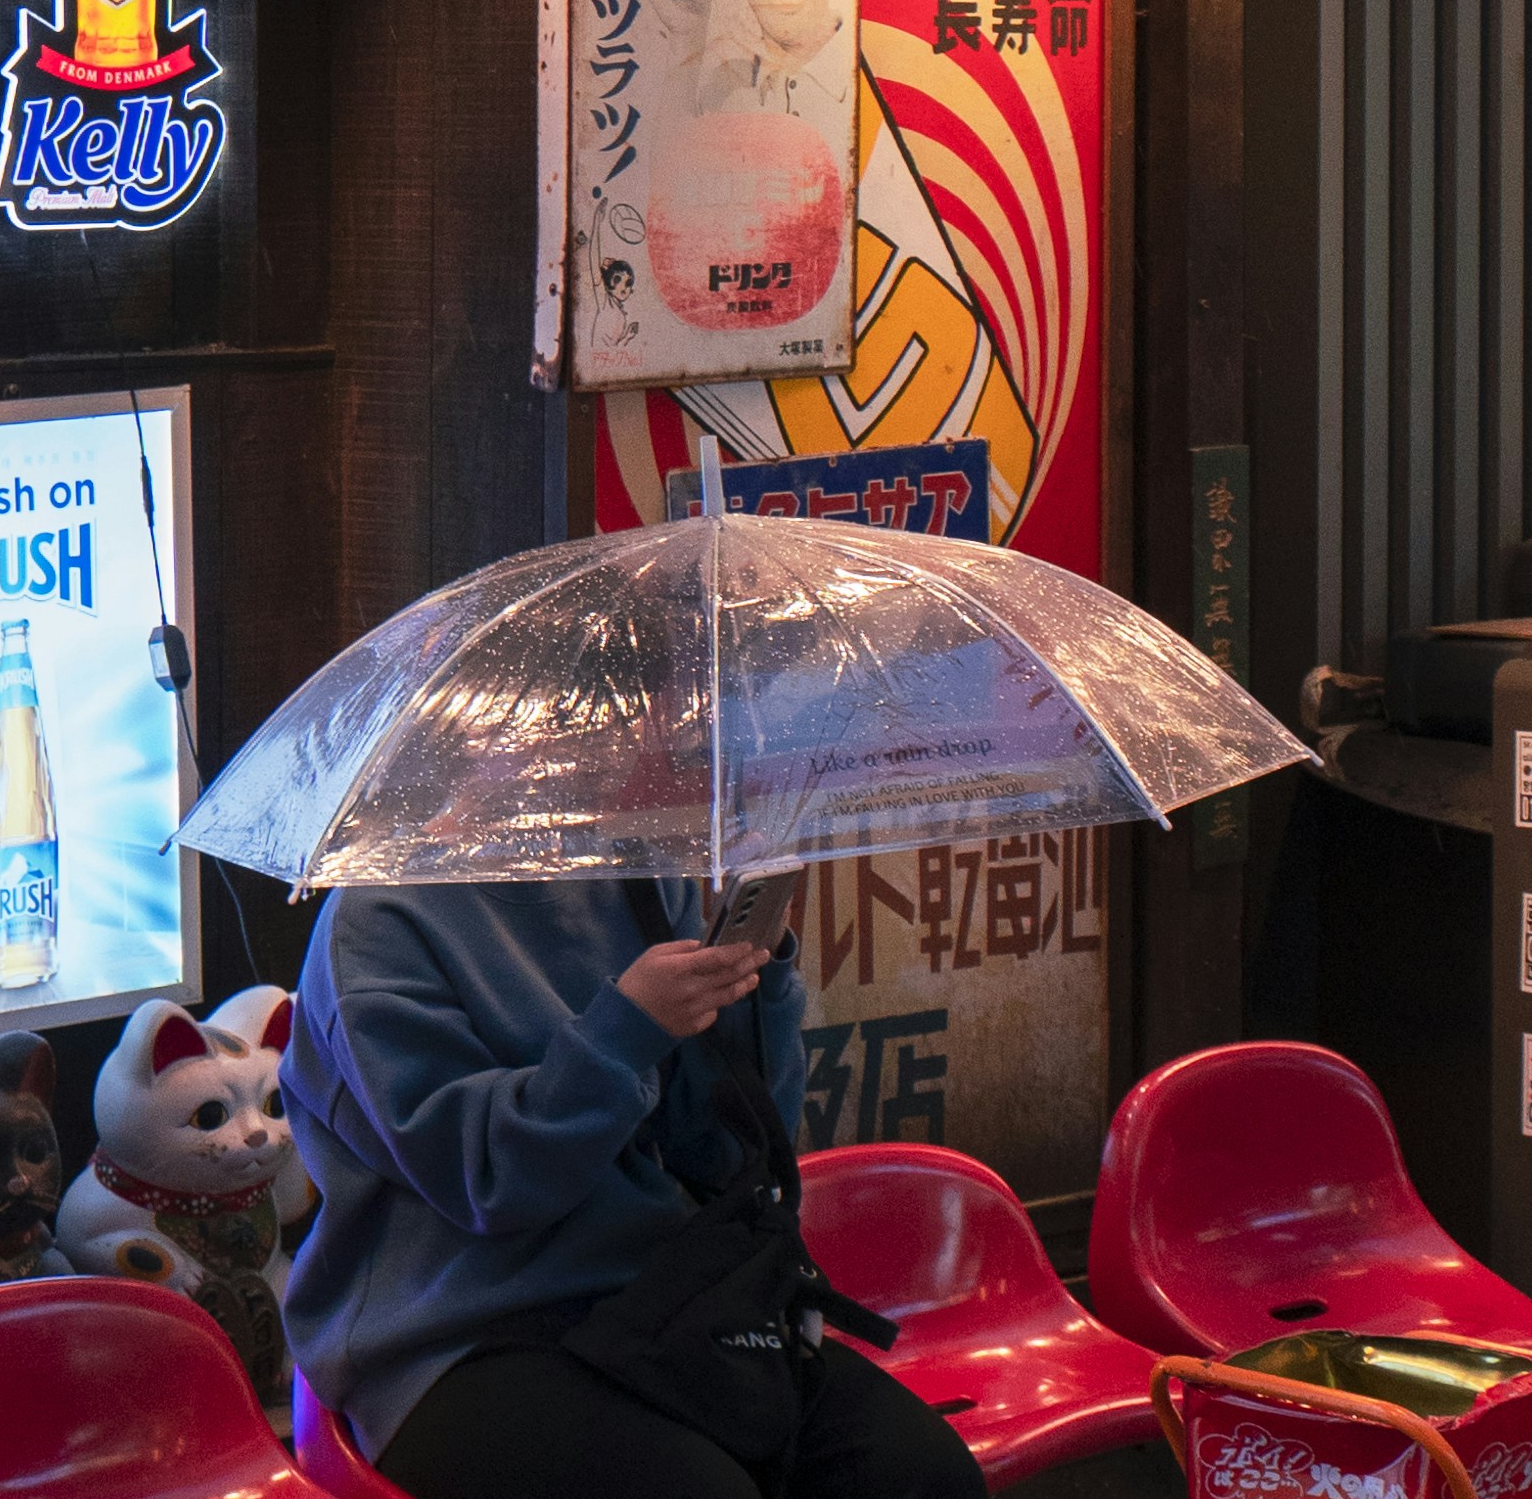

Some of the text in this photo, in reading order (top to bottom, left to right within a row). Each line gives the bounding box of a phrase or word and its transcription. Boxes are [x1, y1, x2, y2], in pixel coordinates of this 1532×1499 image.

[58, 58, 173, 87] FROM DENMARK
[11, 95, 215, 213] Kelly
[26, 184, 120, 213] Premium Malt
[708, 261, 792, 293] ドリンク
[778, 339, 824, 357] 大塚製薬
[49, 477, 97, 509] on
[811, 737, 995, 777] Like a rain drop
[855, 798, 907, 815] FALLING
[909, 796, 923, 809] IN
[923, 791, 959, 807] LOVE
[959, 785, 996, 802] WITH
[997, 781, 1027, 796] YOU
[879, 779, 924, 796] AFRAID
[928, 778, 945, 790] OF
[948, 771, 1000, 788] FALLING
